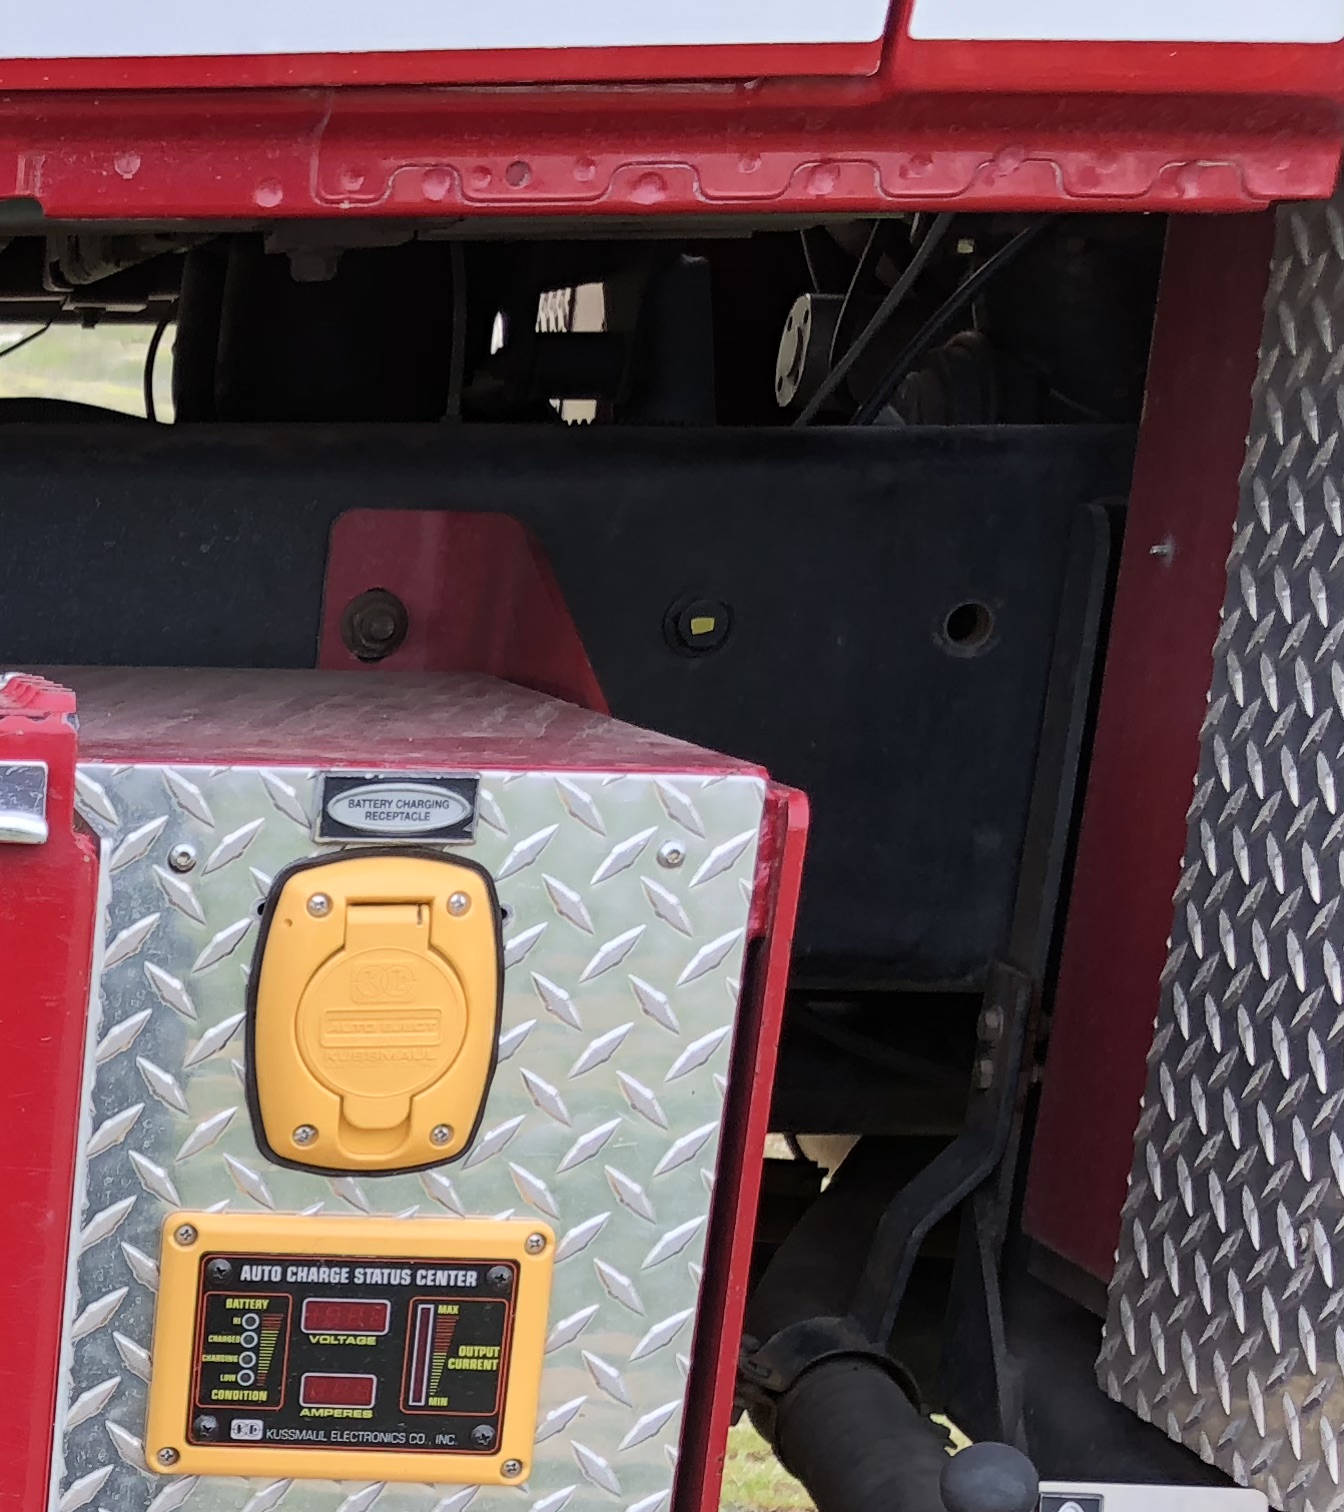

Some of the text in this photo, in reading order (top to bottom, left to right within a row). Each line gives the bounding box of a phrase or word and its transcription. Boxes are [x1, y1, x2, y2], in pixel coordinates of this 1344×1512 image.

[348, 799, 449, 809] BATTERY CHARGING
[365, 811, 431, 821] RECEPTACLE
[240, 1265, 477, 1287] AUTO CHARGE STATUS CENTER
[226, 1298, 269, 1309] BATTERY
[437, 1304, 459, 1315] MAX
[309, 1335, 377, 1345] VOLTAGE
[458, 1345, 500, 1358] OUTPUT
[447, 1357, 499, 1371] CURRENT
[220, 1374, 236, 1382] LOW
[211, 1389, 268, 1401] CONDITION
[428, 1397, 448, 1406] MIN
[299, 1408, 373, 1419] AMPERES
[266, 1428, 326, 1441] KUSSMAUL
[330, 1430, 406, 1443] ELECTRONICS
[435, 1435, 459, 1445] INC.
